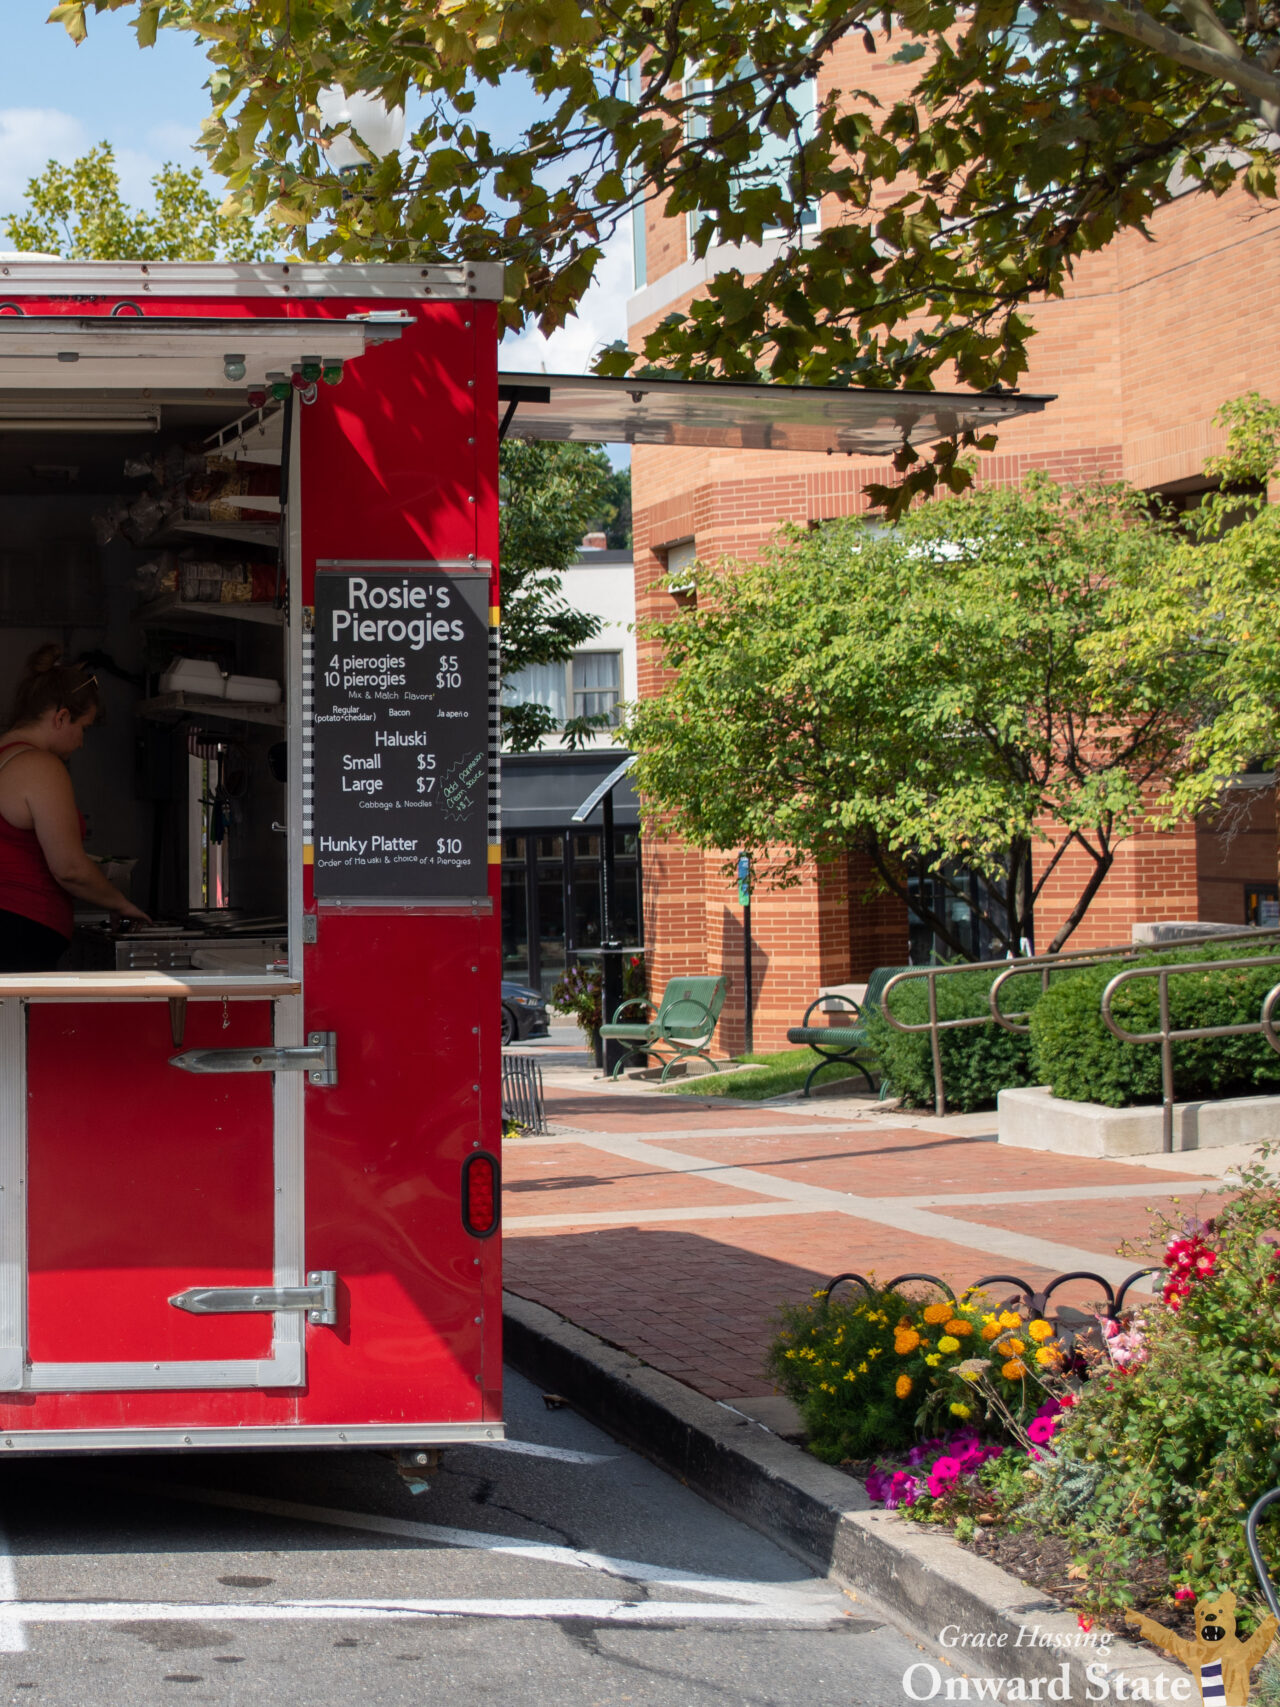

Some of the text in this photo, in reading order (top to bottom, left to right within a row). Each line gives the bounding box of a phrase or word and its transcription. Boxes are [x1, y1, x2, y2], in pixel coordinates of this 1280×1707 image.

[348, 577, 451, 609] Rosie's
[332, 610, 464, 650] Pierogies
[329, 653, 459, 672] 4 pierogies $5
[324, 671, 462, 689] 10 pierogies $10
[348, 691, 362, 699] Mix
[365, 691, 371, 699] &
[374, 691, 399, 700] Match
[332, 705, 360, 716] Regular
[388, 708, 411, 717] Bacon
[375, 730, 427, 747] Haluski
[342, 753, 436, 770] Small $5
[342, 775, 436, 795] Large $7
[358, 800, 393, 811] Cabbage
[404, 800, 433, 808] Noodles
[319, 835, 462, 855] Hunky Platter $10
[317, 858, 342, 868] Order
[344, 857, 353, 866] of
[384, 856, 391, 864] &
[419, 856, 427, 865] of
[436, 856, 471, 868] Pierogies
